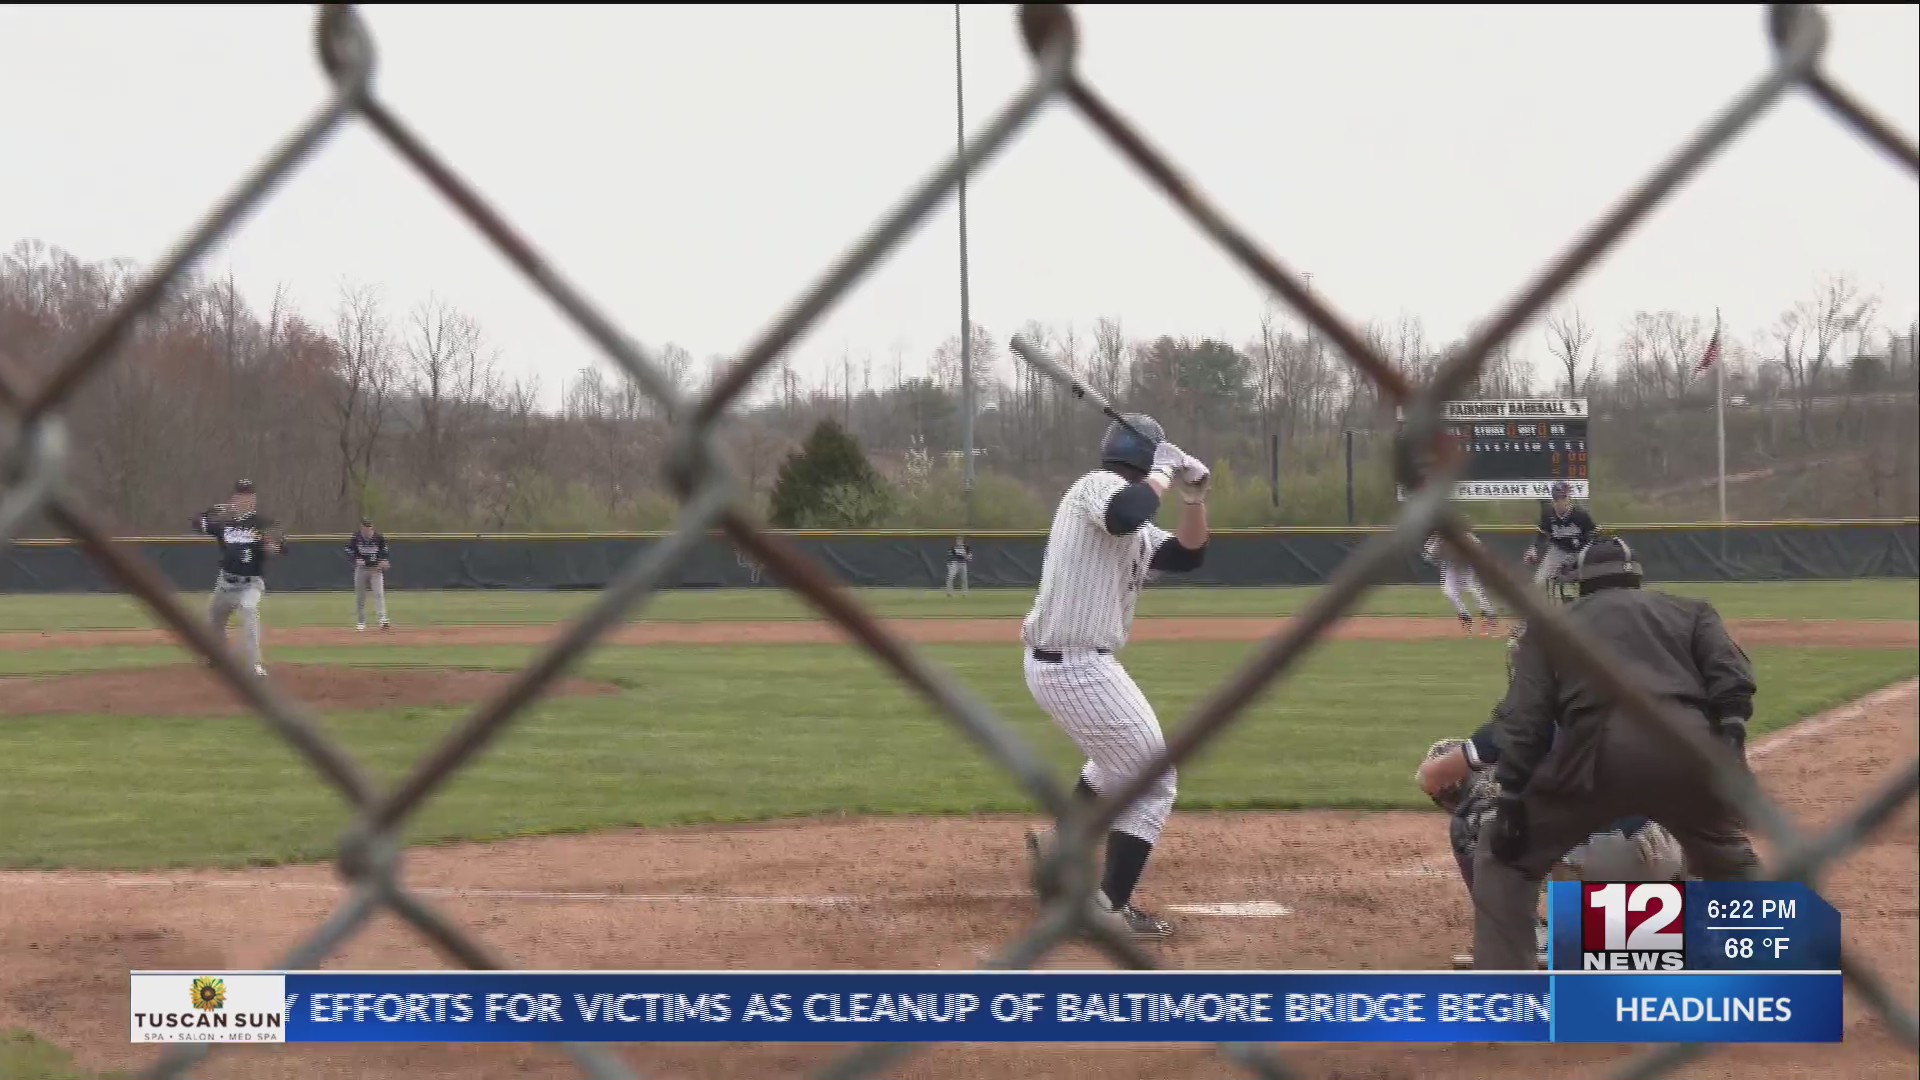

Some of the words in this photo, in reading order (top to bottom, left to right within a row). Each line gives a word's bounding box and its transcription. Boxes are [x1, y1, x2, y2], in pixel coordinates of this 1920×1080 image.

[1449, 402, 1505, 416] FAIRMONT
[1508, 401, 1566, 415] BASEBALL
[1474, 425, 1505, 436] STRIKE
[1518, 425, 1536, 435] OUT
[1459, 486, 1528, 496] PLEASANT
[1533, 485, 1584, 495] VAEY
